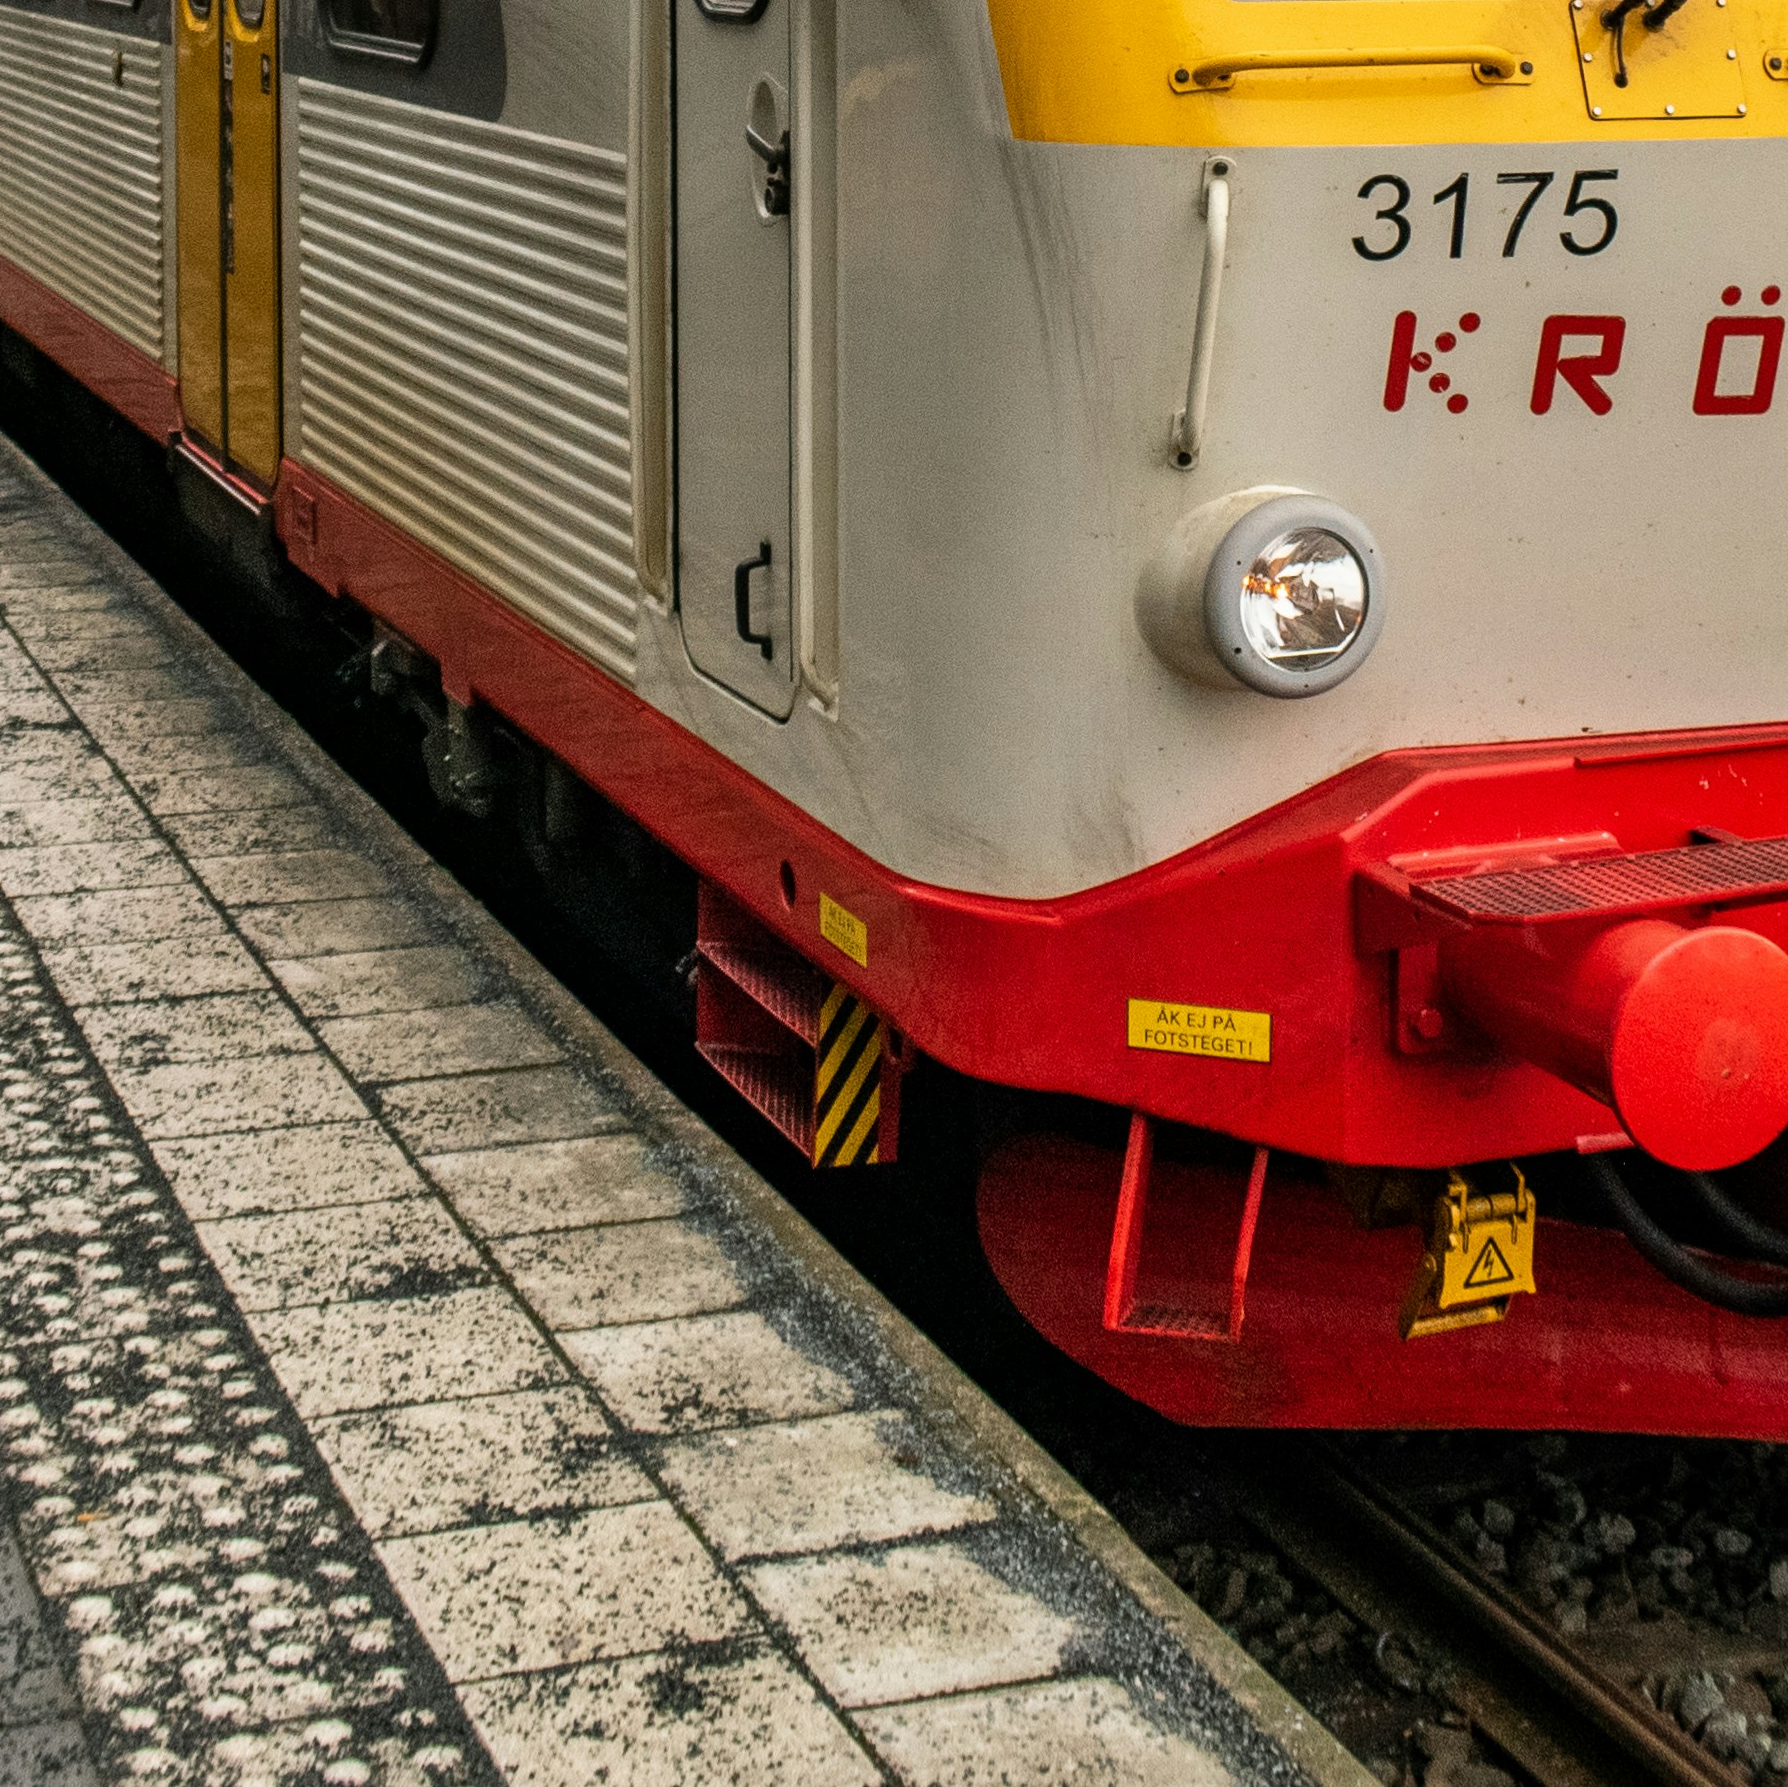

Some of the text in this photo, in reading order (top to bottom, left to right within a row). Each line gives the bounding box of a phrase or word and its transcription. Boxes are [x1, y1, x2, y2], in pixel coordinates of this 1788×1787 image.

[1351, 169, 1619, 261] 3175
[1157, 1005, 1236, 1032] ÅK EJ PÅ
